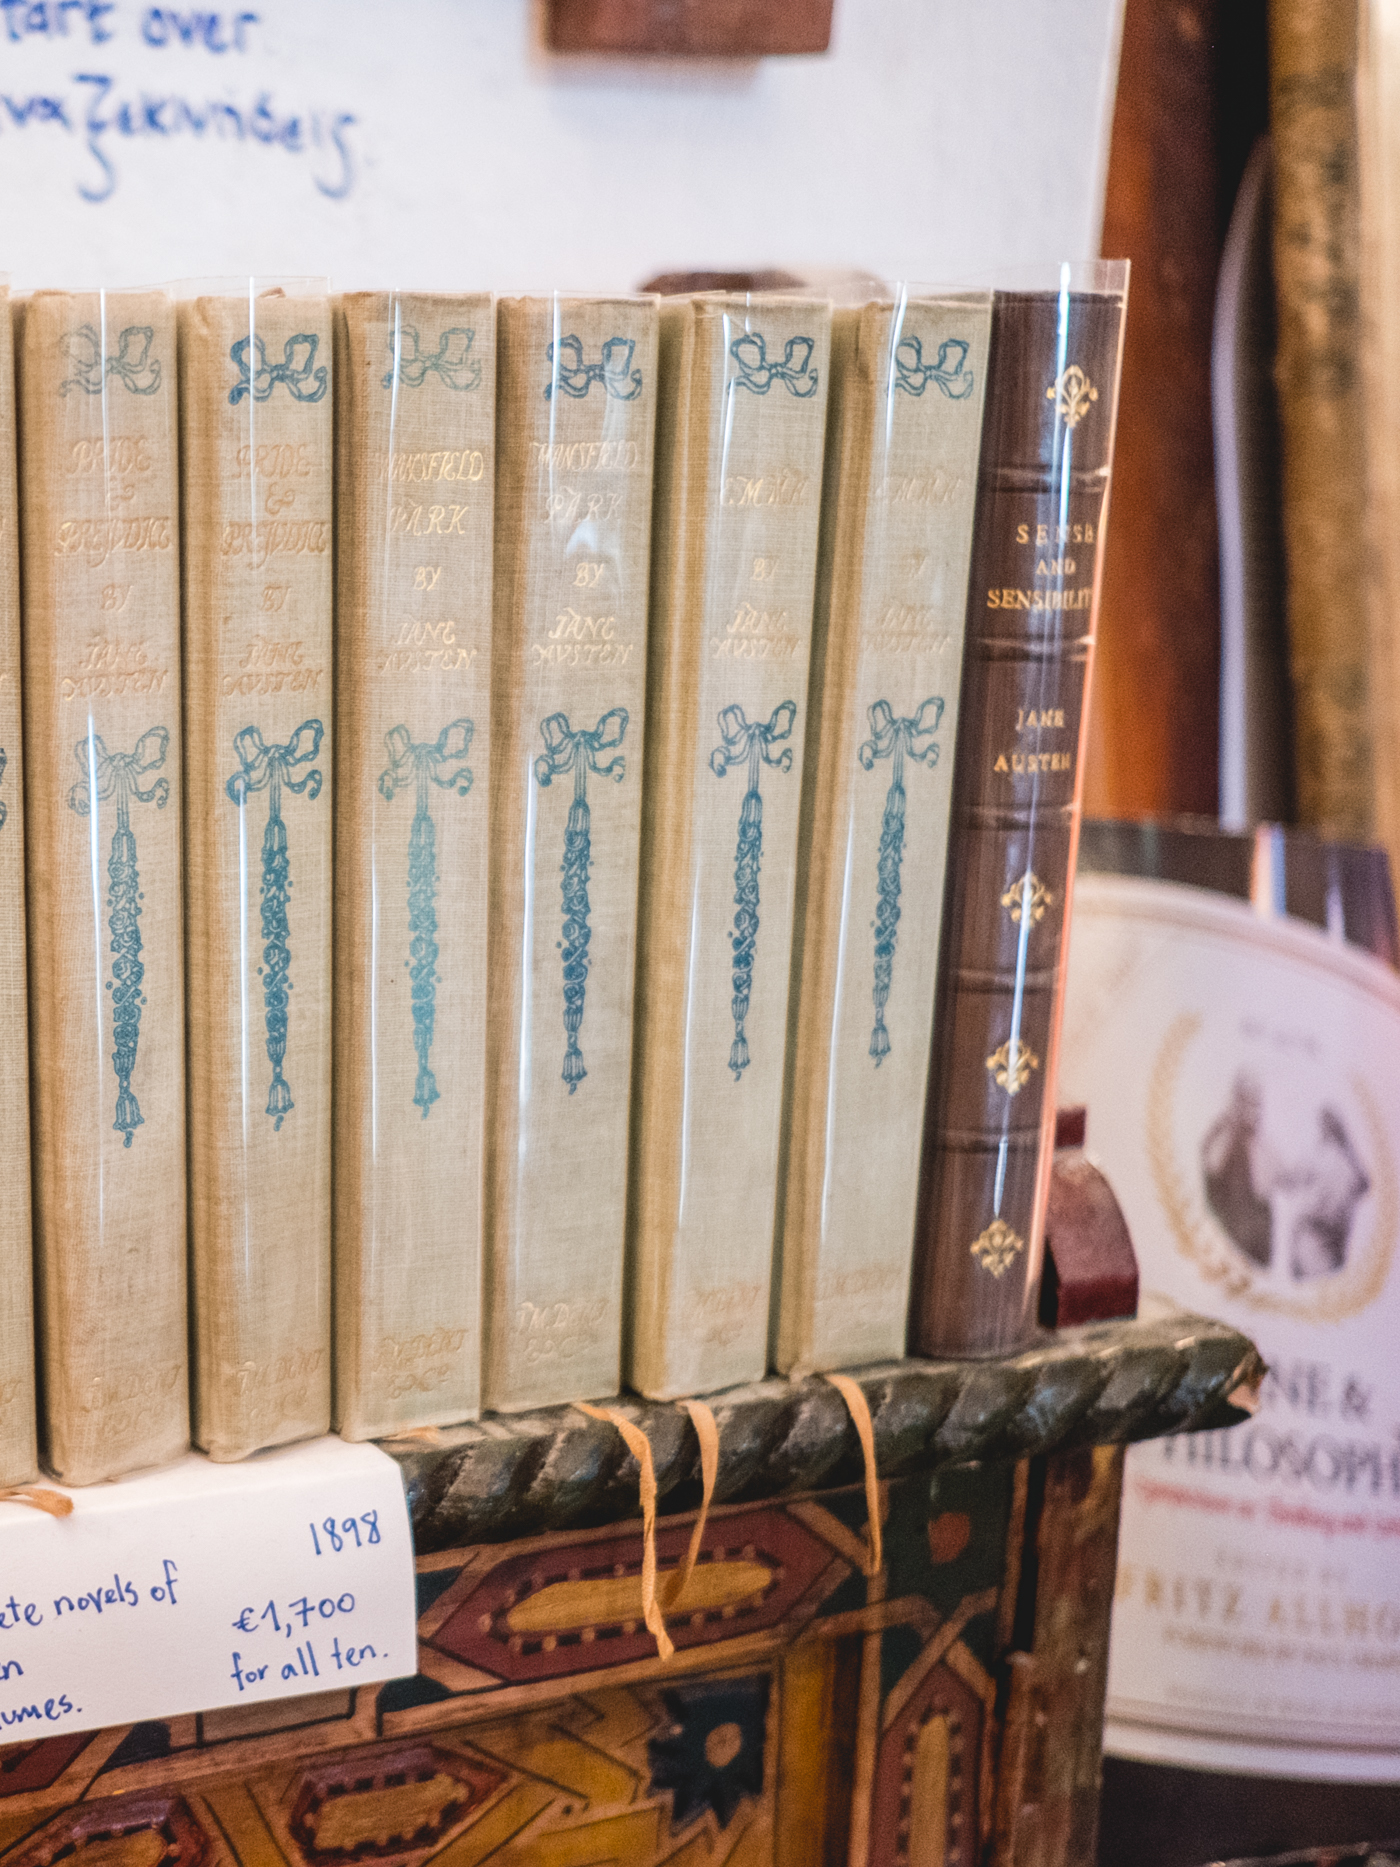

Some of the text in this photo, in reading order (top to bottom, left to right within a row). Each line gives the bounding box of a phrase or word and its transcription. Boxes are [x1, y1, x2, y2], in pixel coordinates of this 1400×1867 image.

[140, 7, 260, 54] over
[412, 565, 442, 591] BY
[572, 561, 605, 588] BY
[1036, 557, 1077, 576] AND
[986, 587, 1094, 611] SENSIBILIT
[547, 606, 616, 640] JANE
[1015, 708, 1066, 731] JANE
[993, 752, 1072, 774] AUSTEN
[309, 1508, 382, 1556] 1898
[52, 1572, 140, 1615] novels
[149, 1557, 179, 1606] of
[231, 1592, 357, 1639] €1,700
[230, 1636, 390, 1692] for all ten.
